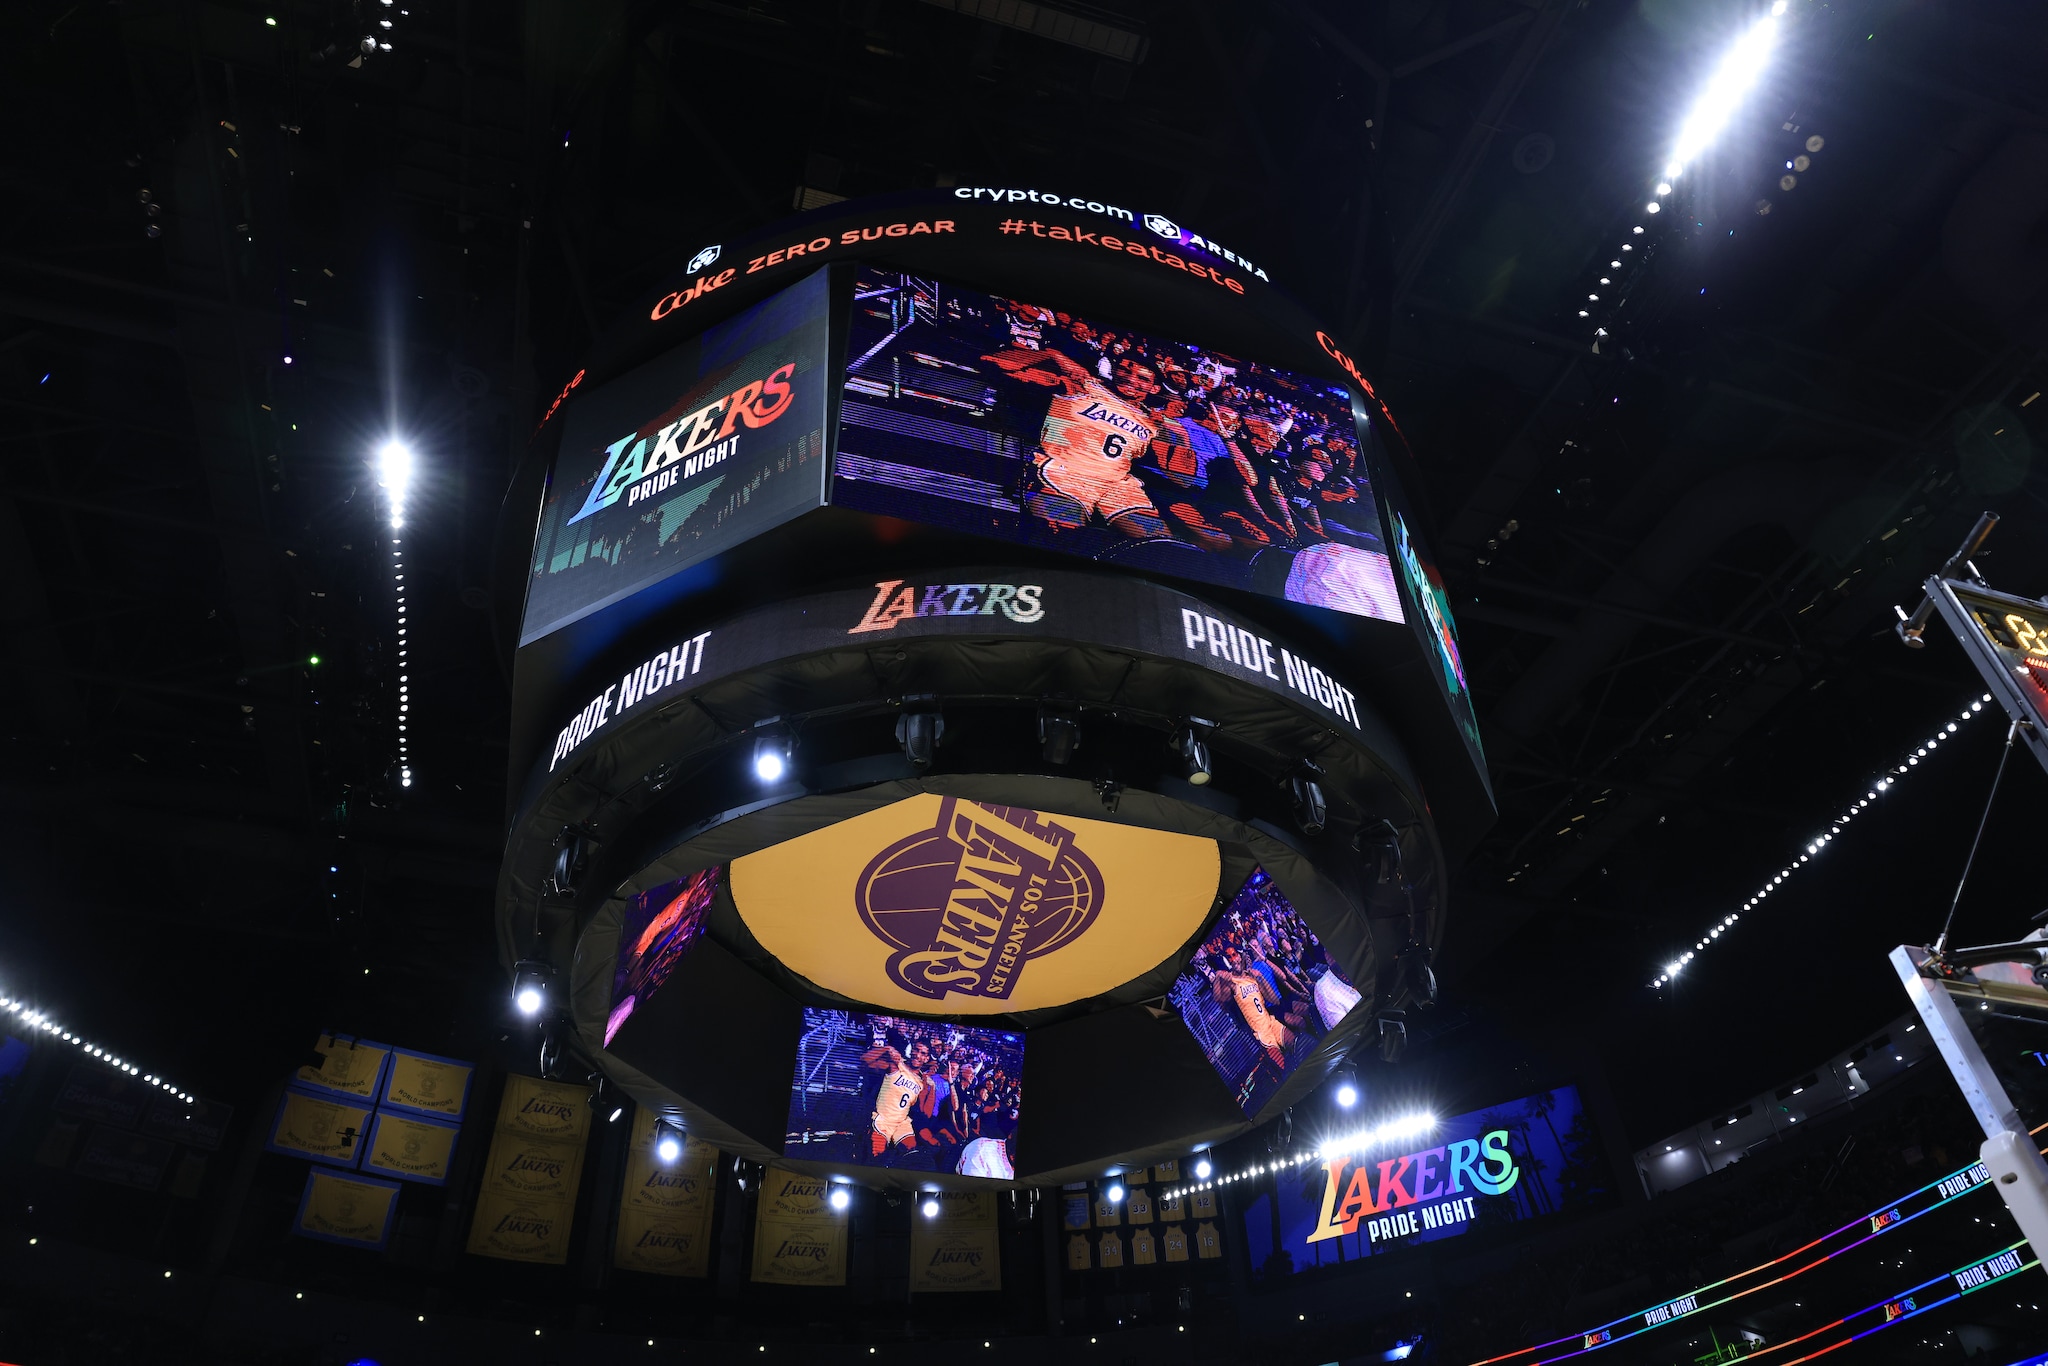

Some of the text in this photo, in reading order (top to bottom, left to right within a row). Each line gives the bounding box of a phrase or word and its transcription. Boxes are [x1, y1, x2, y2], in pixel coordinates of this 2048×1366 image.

[955, 186, 1270, 283] crypto.com ARENA
[650, 220, 956, 320] Coke ZERO SUGAR
[999, 218, 1244, 295] #takeataste
[1315, 329, 1376, 400] Coke
[1077, 402, 1153, 440] LAKERS
[567, 363, 796, 526] LAKERS
[1102, 433, 1127, 459] 6
[628, 435, 740, 507] PRIDE NIGHT
[847, 579, 1046, 634] LAKERS
[1182, 608, 1361, 731] PRIDE NIGHT
[549, 630, 712, 773] PRIDE NIGHT
[898, 798, 1064, 994] LAKERS
[986, 873, 1048, 994] LOS ANGELES
[893, 1074, 921, 1095] LAKERS
[521, 1098, 573, 1121] LAKERS
[899, 1093, 910, 1108] 6
[507, 1154, 564, 1179] LAKERS
[645, 1171, 698, 1193] LAKERS
[1937, 1163, 1991, 1199] PRIDE NIG
[779, 1181, 826, 1200] LAKER
[1306, 1130, 1519, 1244] LAKERS
[775, 1200, 796, 1213] WORLD
[1133, 1204, 1148, 1214] 33
[1368, 1197, 1476, 1243] PRIDE NIGHT
[1870, 1208, 1901, 1233] LAKERS
[494, 1215, 552, 1240] LAKERS
[636, 1230, 690, 1253] LAKERS
[775, 1241, 829, 1262] LAKERS
[929, 1248, 984, 1267] LAKERS
[1955, 1249, 2023, 1290] PRIDE NIGHT
[1644, 1295, 1698, 1326] PRIDE NIGHT
[1884, 1296, 1917, 1323] LAKERS
[1584, 1329, 1611, 1349] LAKERS
